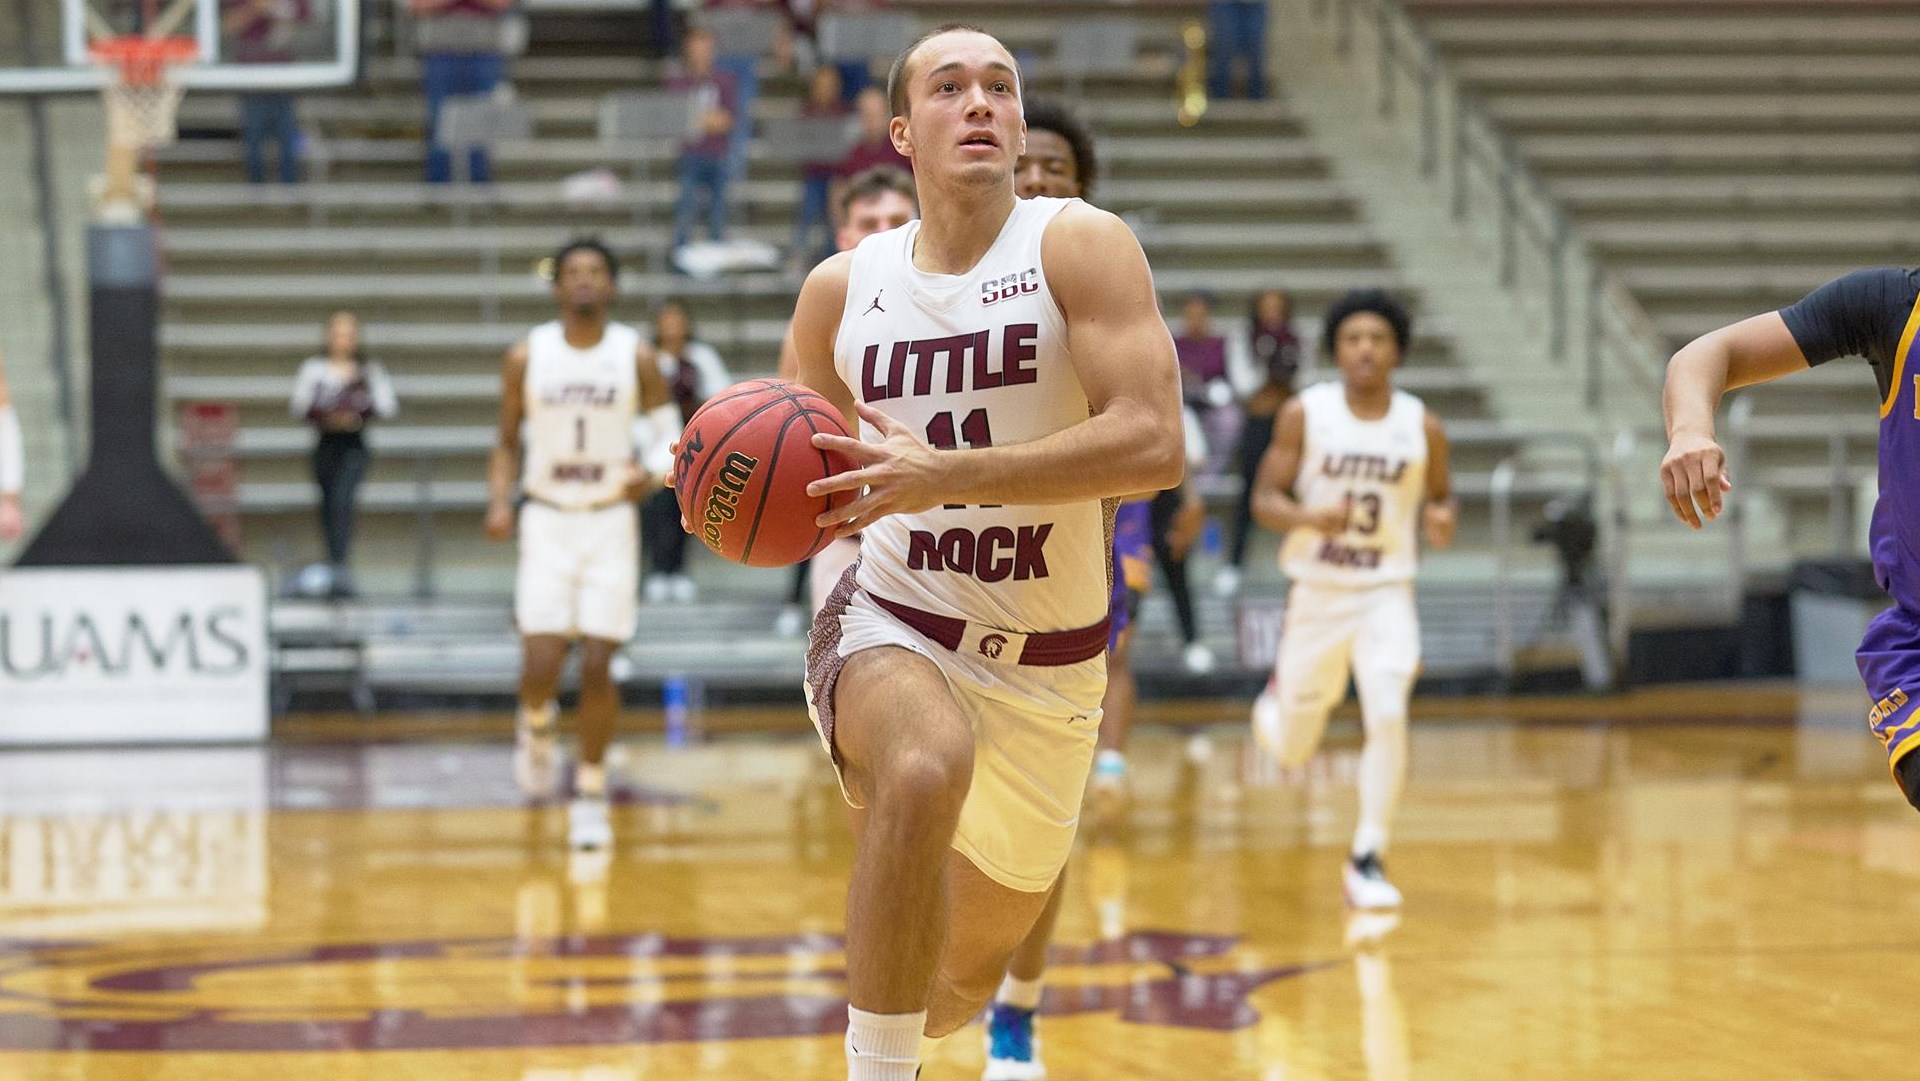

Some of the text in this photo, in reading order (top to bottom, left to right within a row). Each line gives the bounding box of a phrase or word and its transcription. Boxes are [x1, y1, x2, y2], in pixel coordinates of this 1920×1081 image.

[981, 267, 1038, 305] SBC
[861, 323, 1038, 403] LITTLE
[574, 416, 587, 451] 1
[1343, 491, 1382, 535] 13
[907, 523, 1054, 582] ROCK
[0, 604, 249, 681] UAMS
